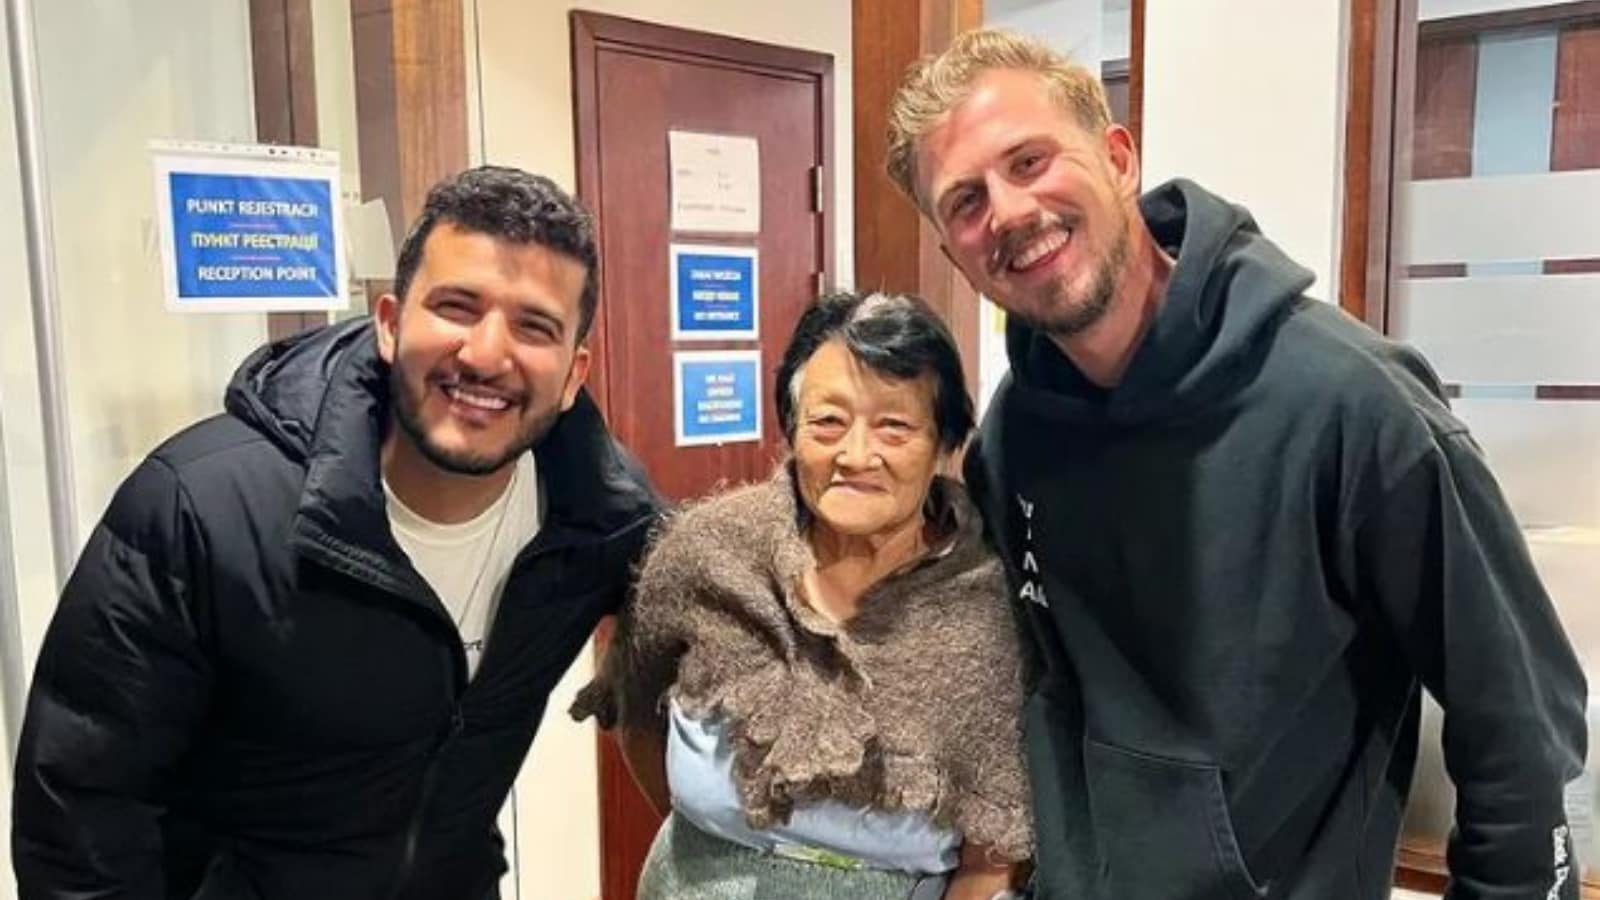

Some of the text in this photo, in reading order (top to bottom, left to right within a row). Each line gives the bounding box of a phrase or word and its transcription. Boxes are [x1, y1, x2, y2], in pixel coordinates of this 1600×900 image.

[186, 198, 319, 217] PUNKT REJESTRACJI
[191, 232, 239, 249] ПУНКТ
[198, 266, 317, 281] RECEPTION POINT
